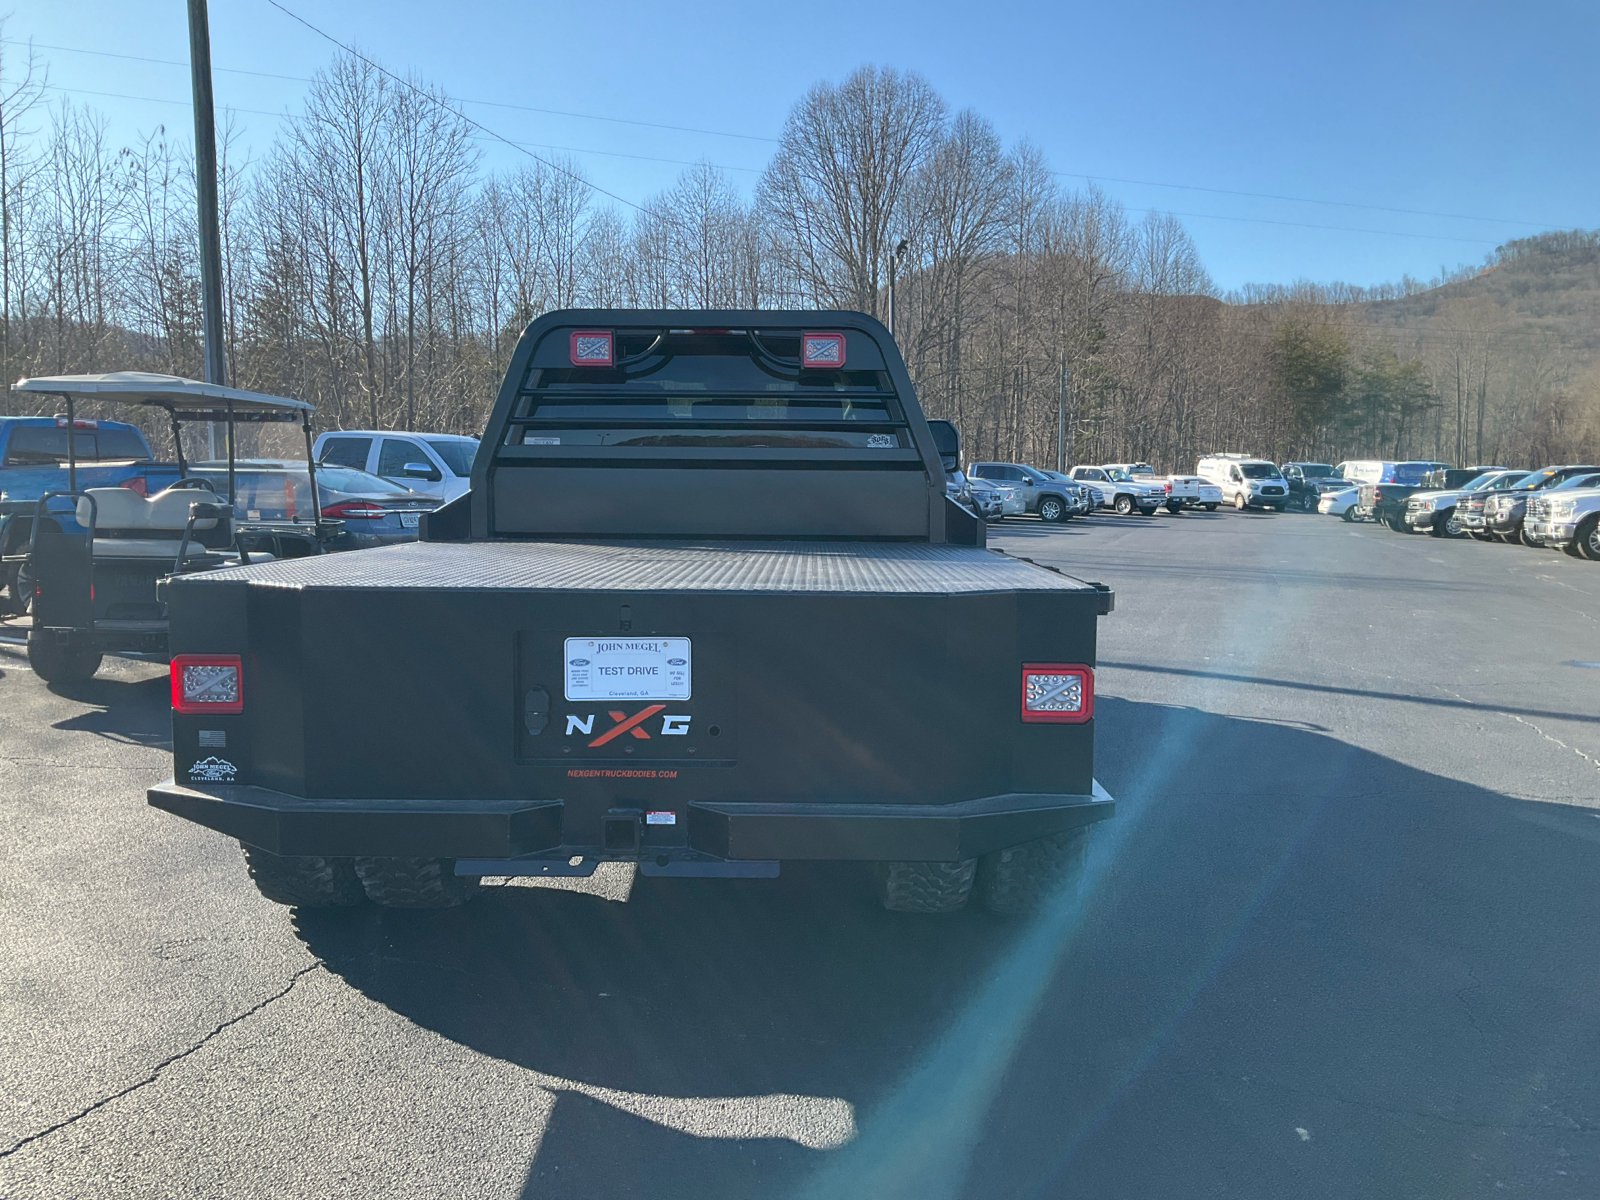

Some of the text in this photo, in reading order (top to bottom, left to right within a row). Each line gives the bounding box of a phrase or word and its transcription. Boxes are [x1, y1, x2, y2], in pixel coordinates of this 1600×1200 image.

[596, 642, 661, 654] JOHN MEGEL
[669, 658, 685, 666] Ford
[598, 666, 625, 676] TEST
[627, 666, 659, 675] DRIVE
[565, 704, 692, 747] NXG
[567, 769, 678, 778] NEXGENTRUCKBODIES.COM
